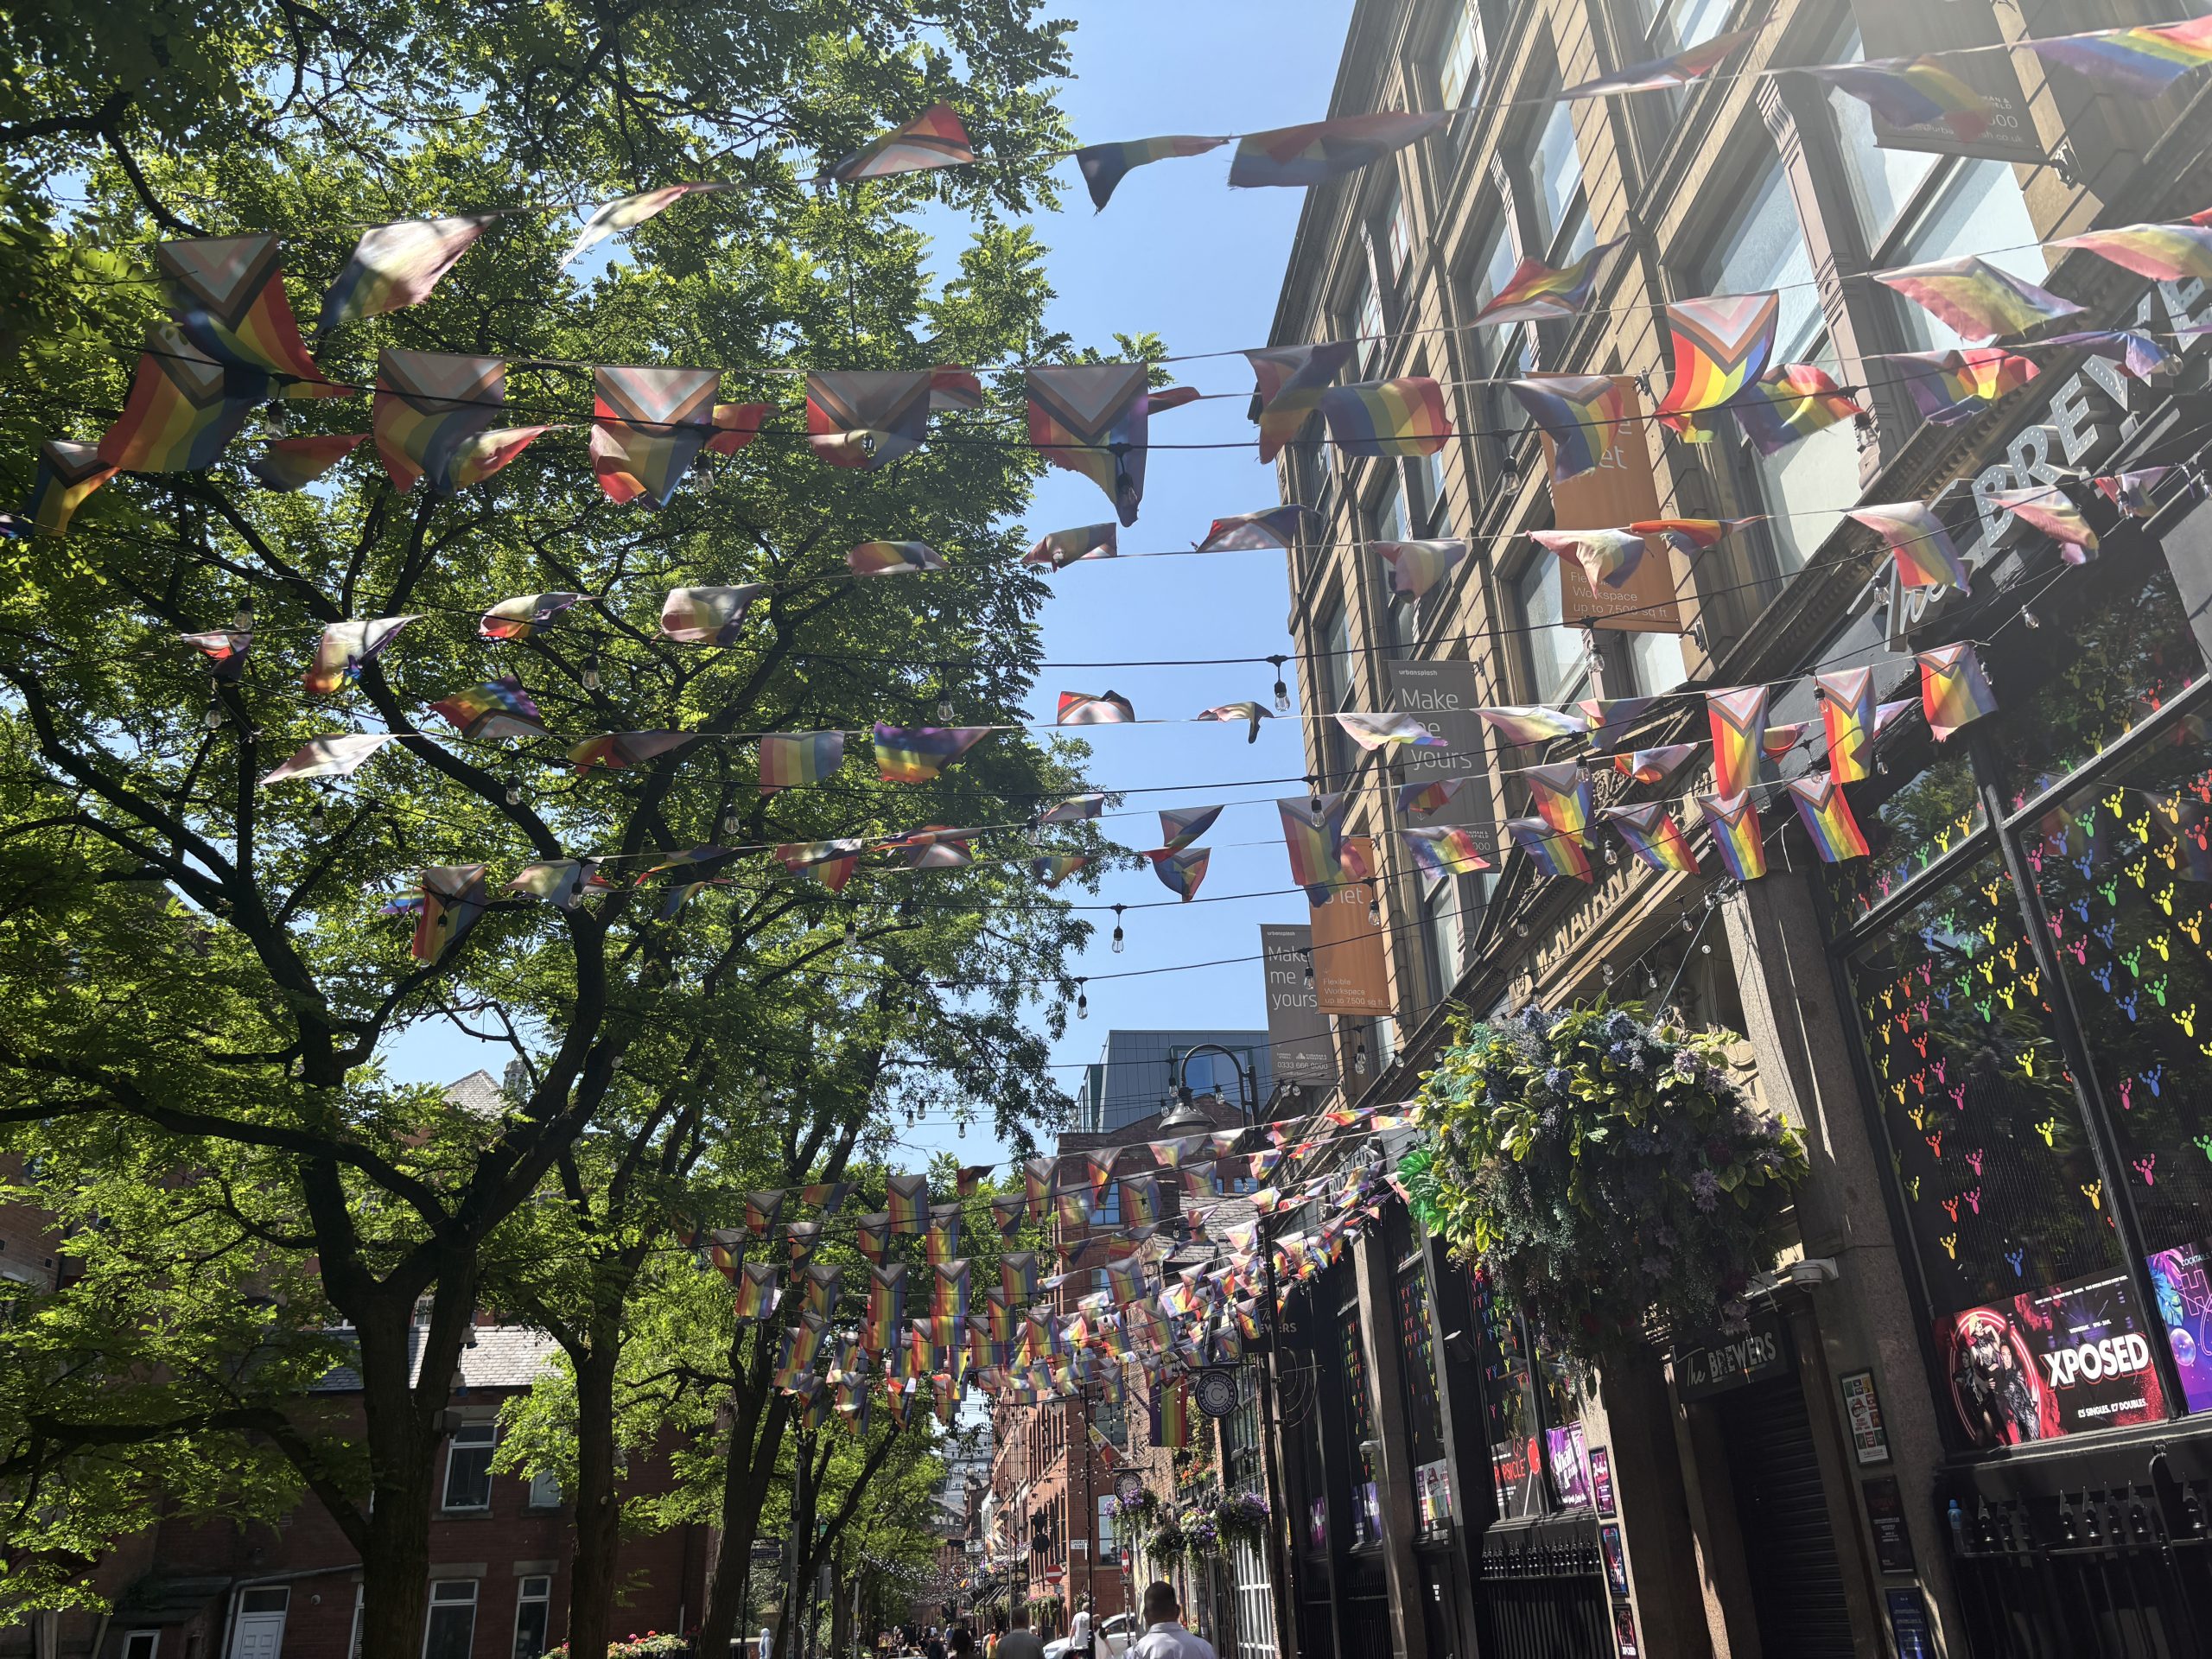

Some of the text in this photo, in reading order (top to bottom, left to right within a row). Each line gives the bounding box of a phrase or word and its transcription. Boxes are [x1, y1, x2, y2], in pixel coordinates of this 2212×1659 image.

[1572, 586, 1638, 601] Wokspace
[1573, 604, 1588, 614] up
[1592, 603, 1604, 613] to
[1659, 607, 1668, 618] ft
[1402, 688, 1459, 710] Make
[1411, 748, 1472, 771] yours
[1268, 945, 1311, 963] Make
[1270, 970, 1297, 984] me
[1323, 977, 1351, 986] Flexible
[1324, 988, 1365, 996] Workspace
[1272, 992, 1318, 1010] yours
[1676, 1332, 1777, 1388] The BREWERS
[2043, 1332, 2150, 1388] XPOSED
[1210, 1376, 1233, 1390] CHURCH
